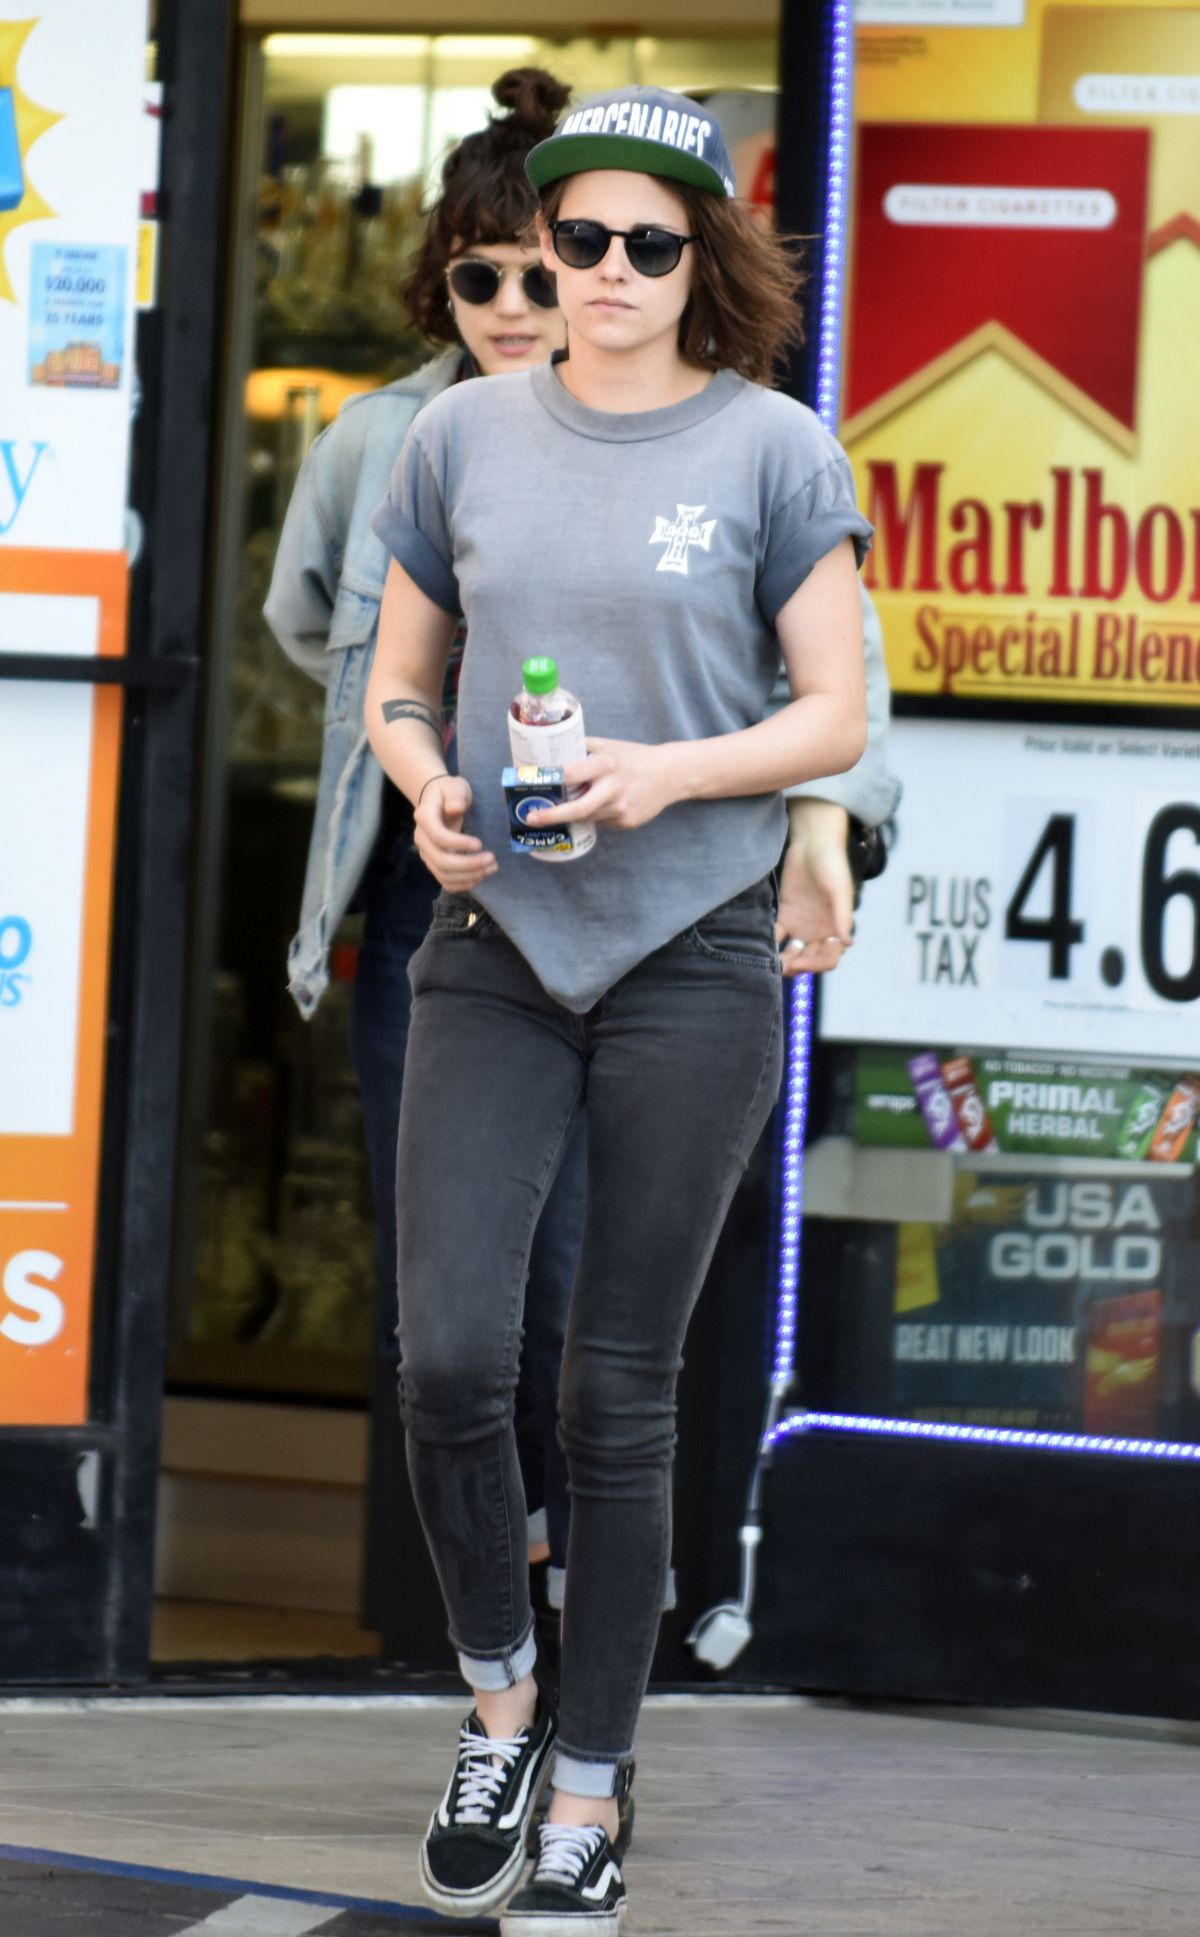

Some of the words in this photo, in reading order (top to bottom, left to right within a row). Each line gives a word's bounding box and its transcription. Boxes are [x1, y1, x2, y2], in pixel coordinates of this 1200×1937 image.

[560, 102, 712, 158] MERCENARIES
[900, 195, 968, 213] FILTER
[976, 198, 1102, 217] CIGARETTES
[45, 275, 106, 294] $20,000
[913, 605, 1081, 694] Special
[1091, 612, 1200, 684] Blen
[517, 833, 565, 848] CAMEL
[907, 875, 992, 929] PLUS
[916, 933, 981, 986] TAX
[988, 1080, 1123, 1115] PRIMAL
[1007, 1111, 1104, 1139] HERBAL
[1025, 1182, 1160, 1229] USA
[990, 1231, 1162, 1279] GOLD
[956, 1325, 1009, 1362] NEW
[1013, 1326, 1077, 1363] LOOK
